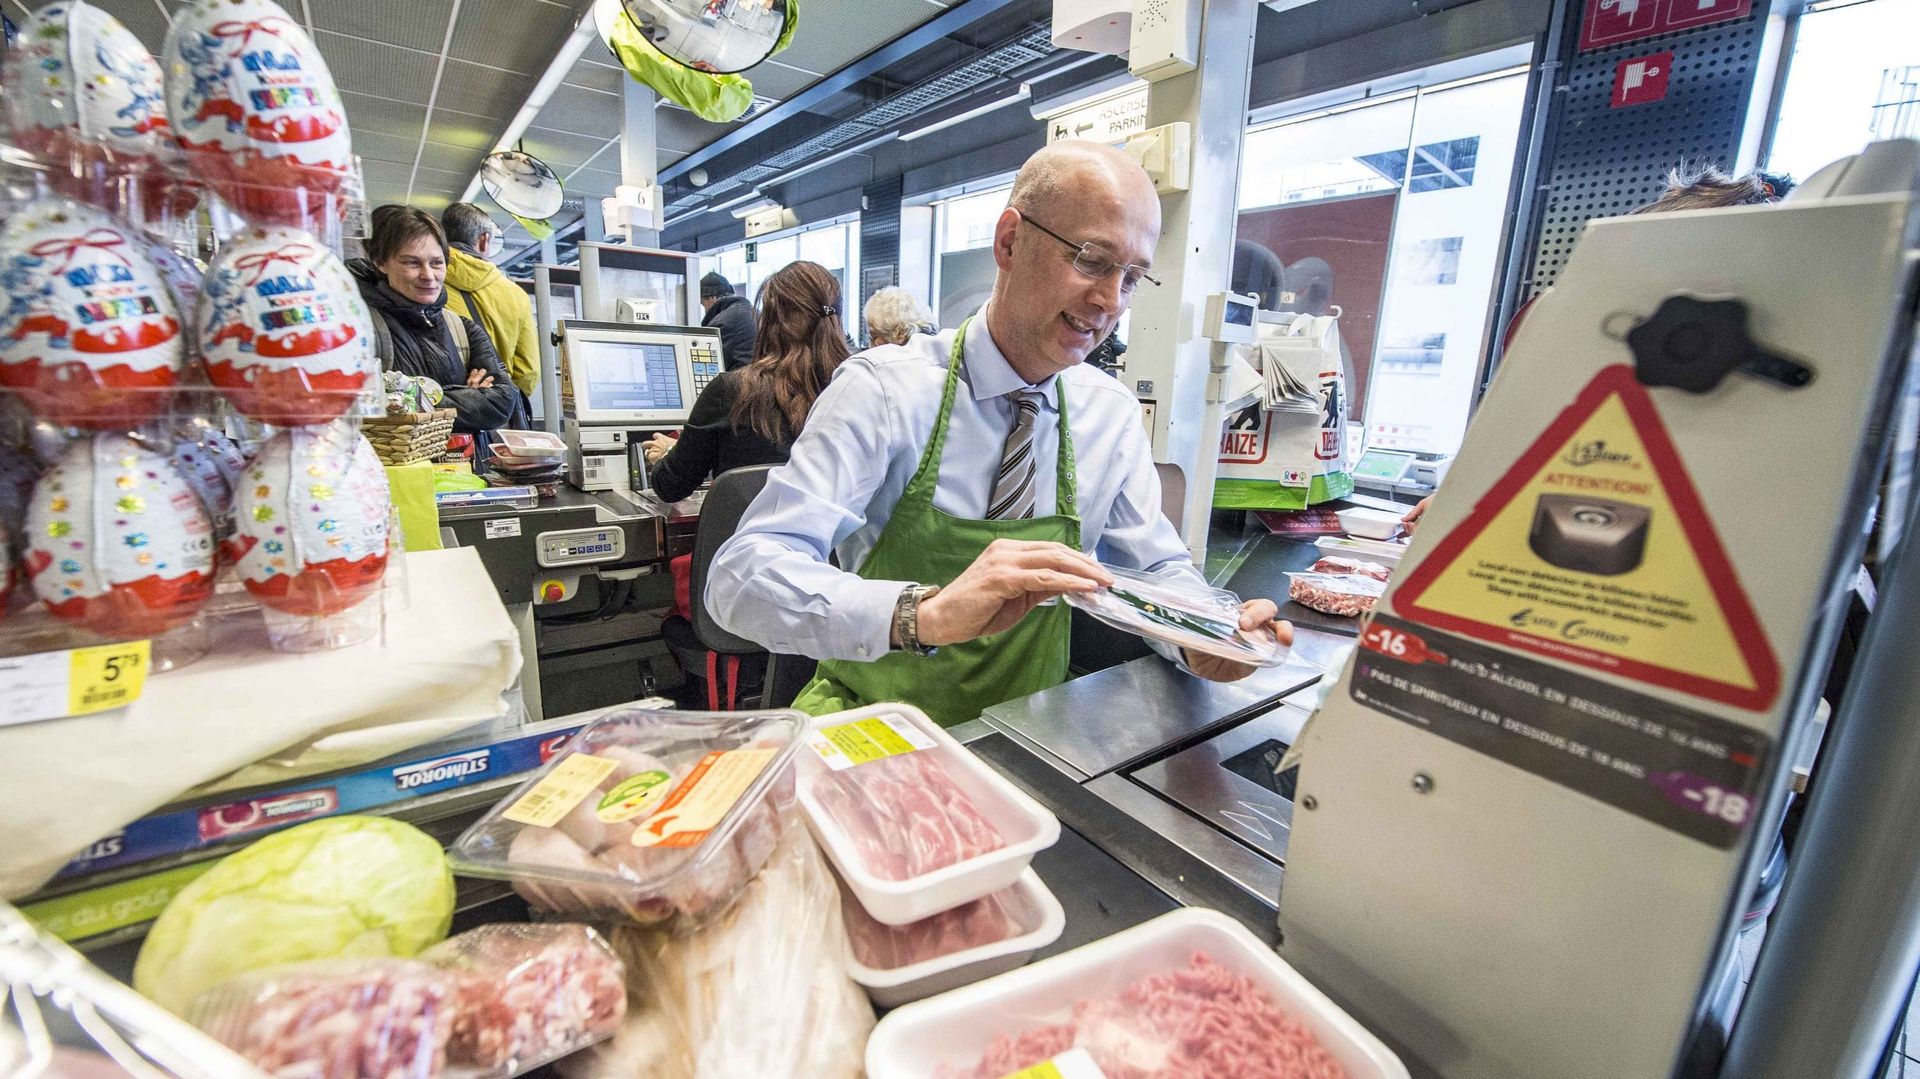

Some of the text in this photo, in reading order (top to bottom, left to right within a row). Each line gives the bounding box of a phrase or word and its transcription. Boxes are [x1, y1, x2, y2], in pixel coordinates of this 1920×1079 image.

[1367, 629, 1407, 655] -16
[1370, 668, 1393, 685] PAS
[1392, 676, 1410, 691] DE
[1409, 683, 1479, 717] SPIRITUEUX
[1479, 708, 1501, 725] EN
[1502, 716, 1567, 750] DESSOUS
[1450, 658, 1477, 675] PAS
[1543, 687, 1567, 704] EN
[1568, 695, 1641, 730] DESSOUS
[397, 757, 488, 789] STIMOROL
[1681, 785, 1750, 824] -18
